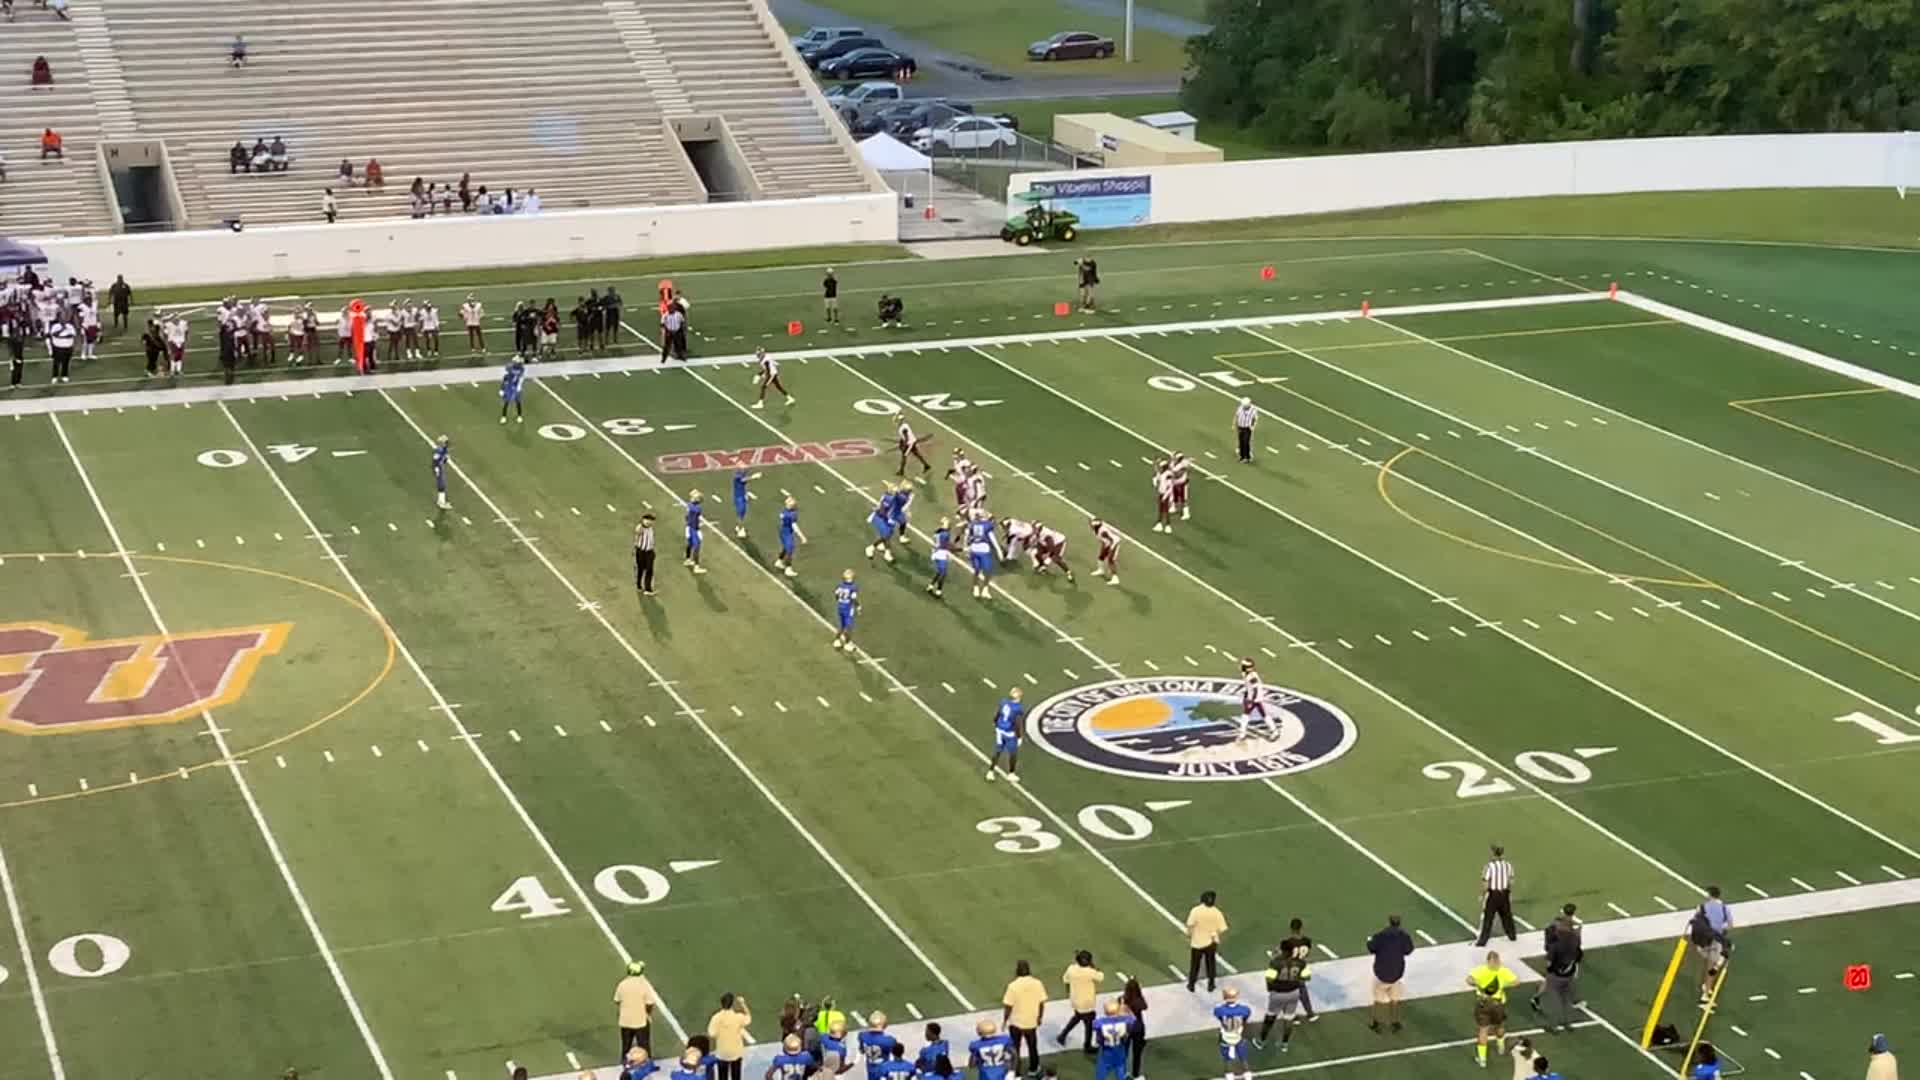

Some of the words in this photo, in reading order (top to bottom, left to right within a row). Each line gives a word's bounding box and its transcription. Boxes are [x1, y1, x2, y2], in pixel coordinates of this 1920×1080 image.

[1057, 182, 1101, 194] Vitamin
[657, 438, 878, 473] SWAC
[1106, 680, 1214, 698] DAYTONA
[1167, 762, 1241, 776] JULY
[1422, 751, 1592, 798] 20
[976, 804, 1153, 853] 30
[490, 864, 671, 919] 40
[1850, 967, 1868, 987] 20
